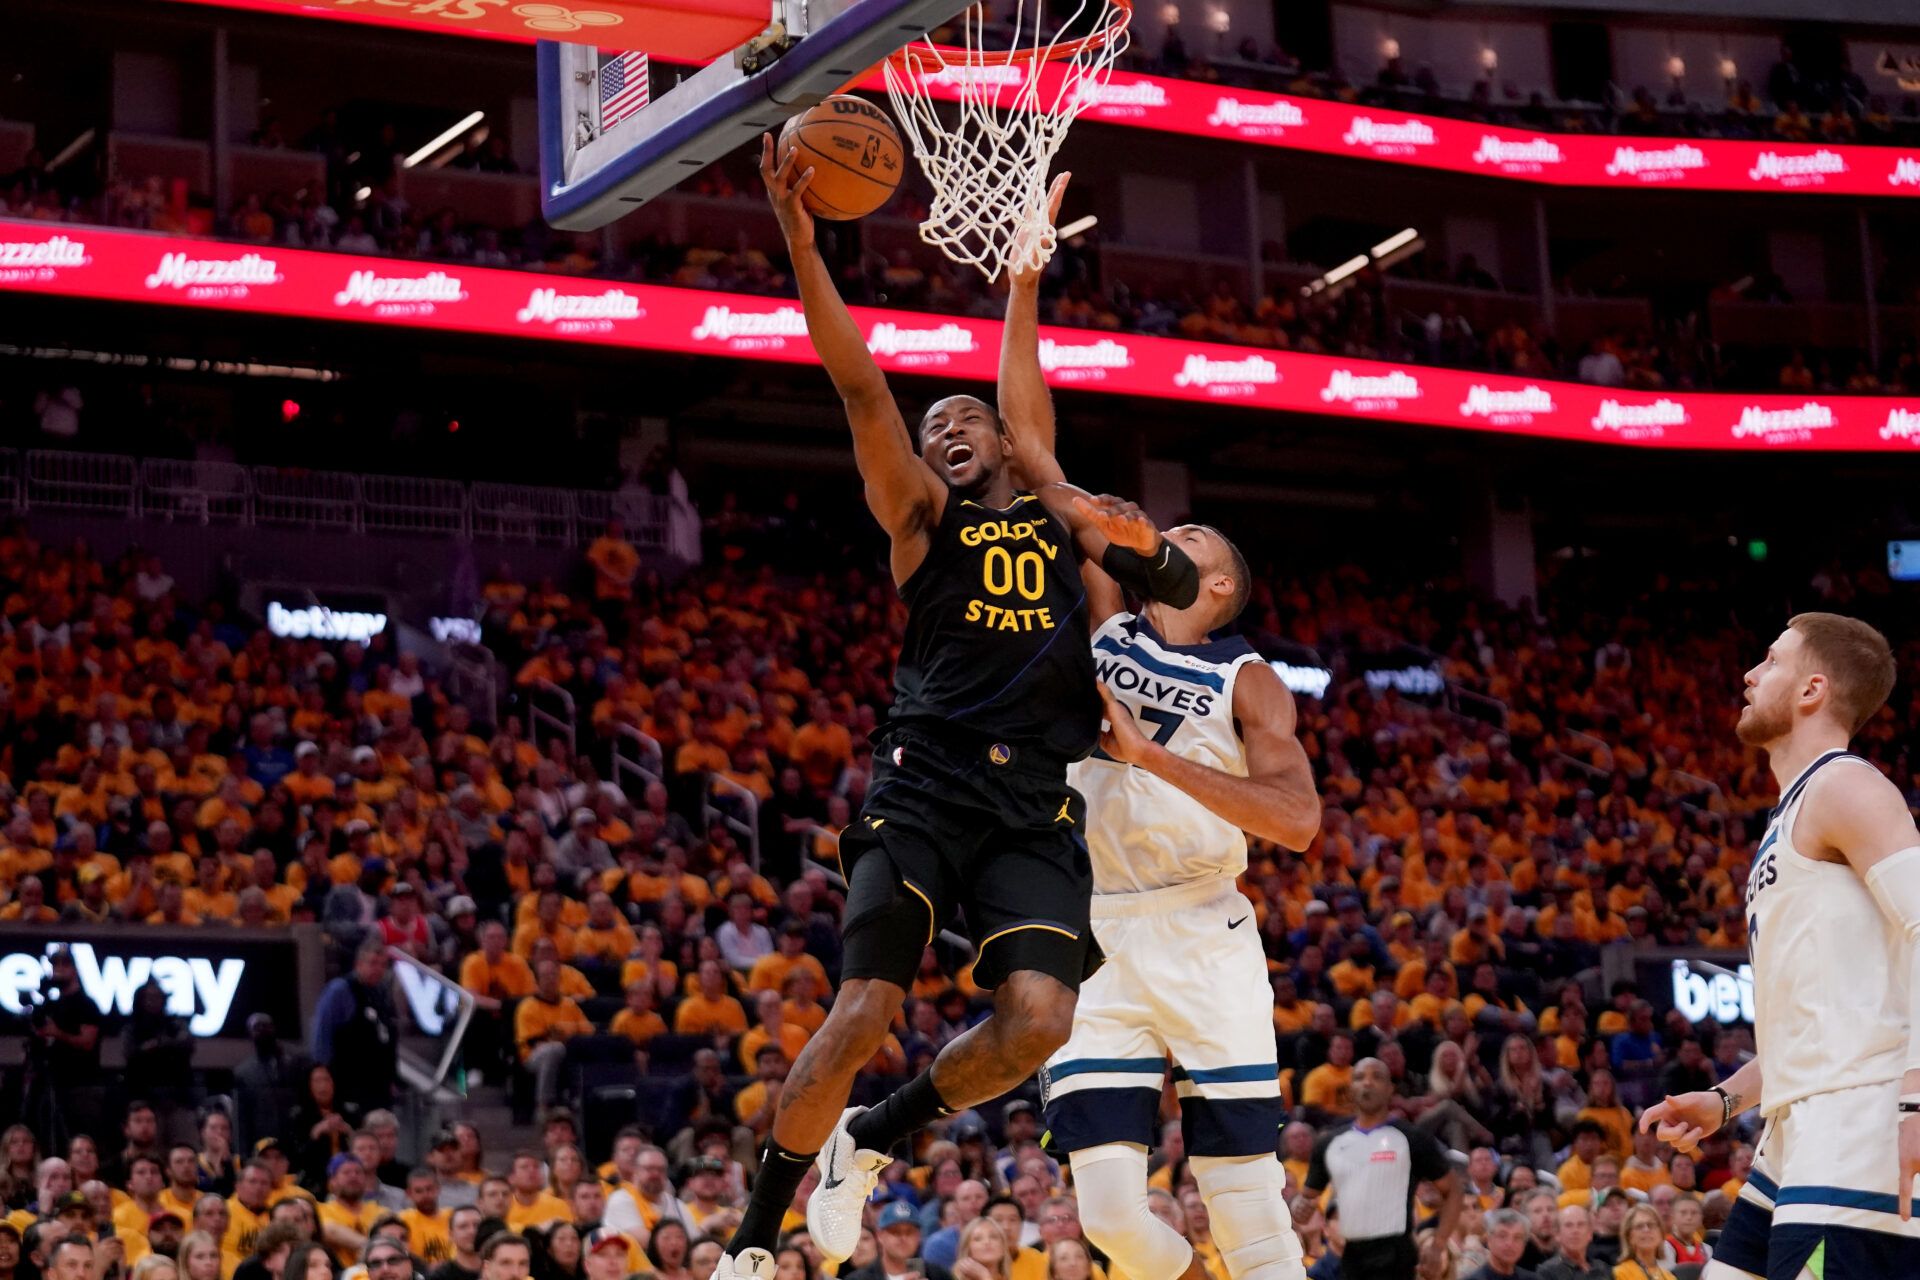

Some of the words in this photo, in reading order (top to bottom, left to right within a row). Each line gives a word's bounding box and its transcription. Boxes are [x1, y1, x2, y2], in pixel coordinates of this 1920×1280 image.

[145, 252, 283, 289] Mezzetta
[334, 270, 466, 307] Mezzetta
[516, 287, 645, 323] Mezzetta
[984, 545, 1046, 601] 00
[267, 601, 387, 648] betway
[964, 599, 1056, 633] STATE
[1095, 658, 1214, 717] WOLVES
